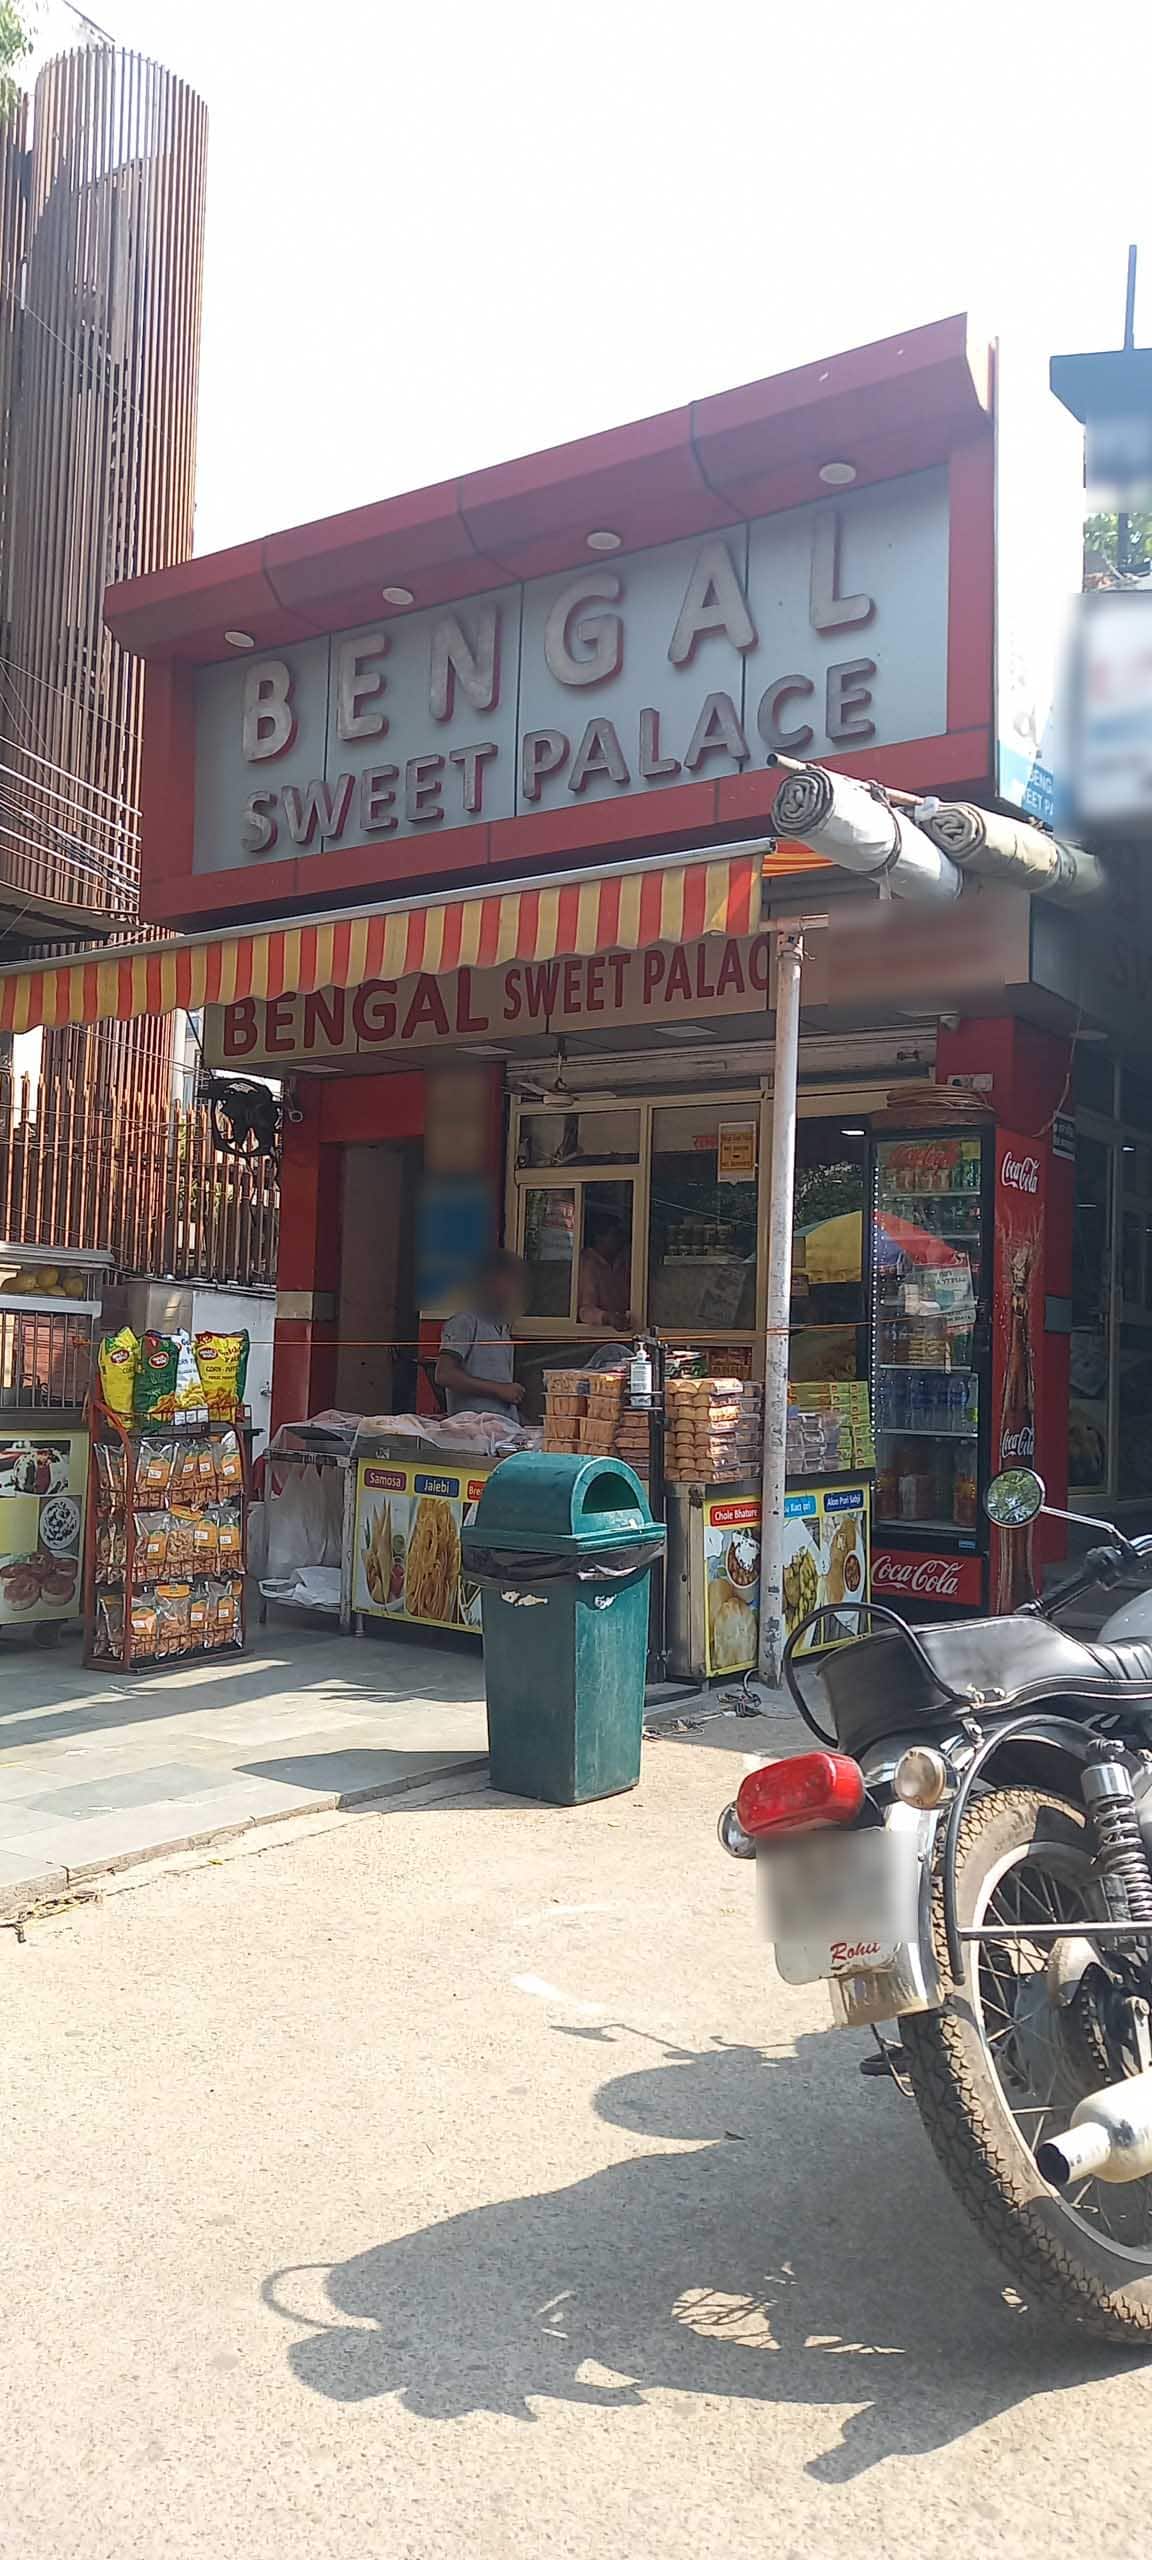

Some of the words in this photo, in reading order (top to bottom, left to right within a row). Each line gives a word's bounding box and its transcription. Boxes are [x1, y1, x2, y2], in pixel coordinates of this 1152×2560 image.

[242, 512, 877, 764] BENGAL
[240, 742, 498, 852] SWEET
[522, 657, 878, 803] PALACE
[223, 967, 489, 1056] BENGAL
[503, 953, 632, 1021] SWEET
[369, 1472, 401, 1488] Samosa
[424, 1479, 450, 1494] Jalebi
[714, 1508, 733, 1521] Chole
